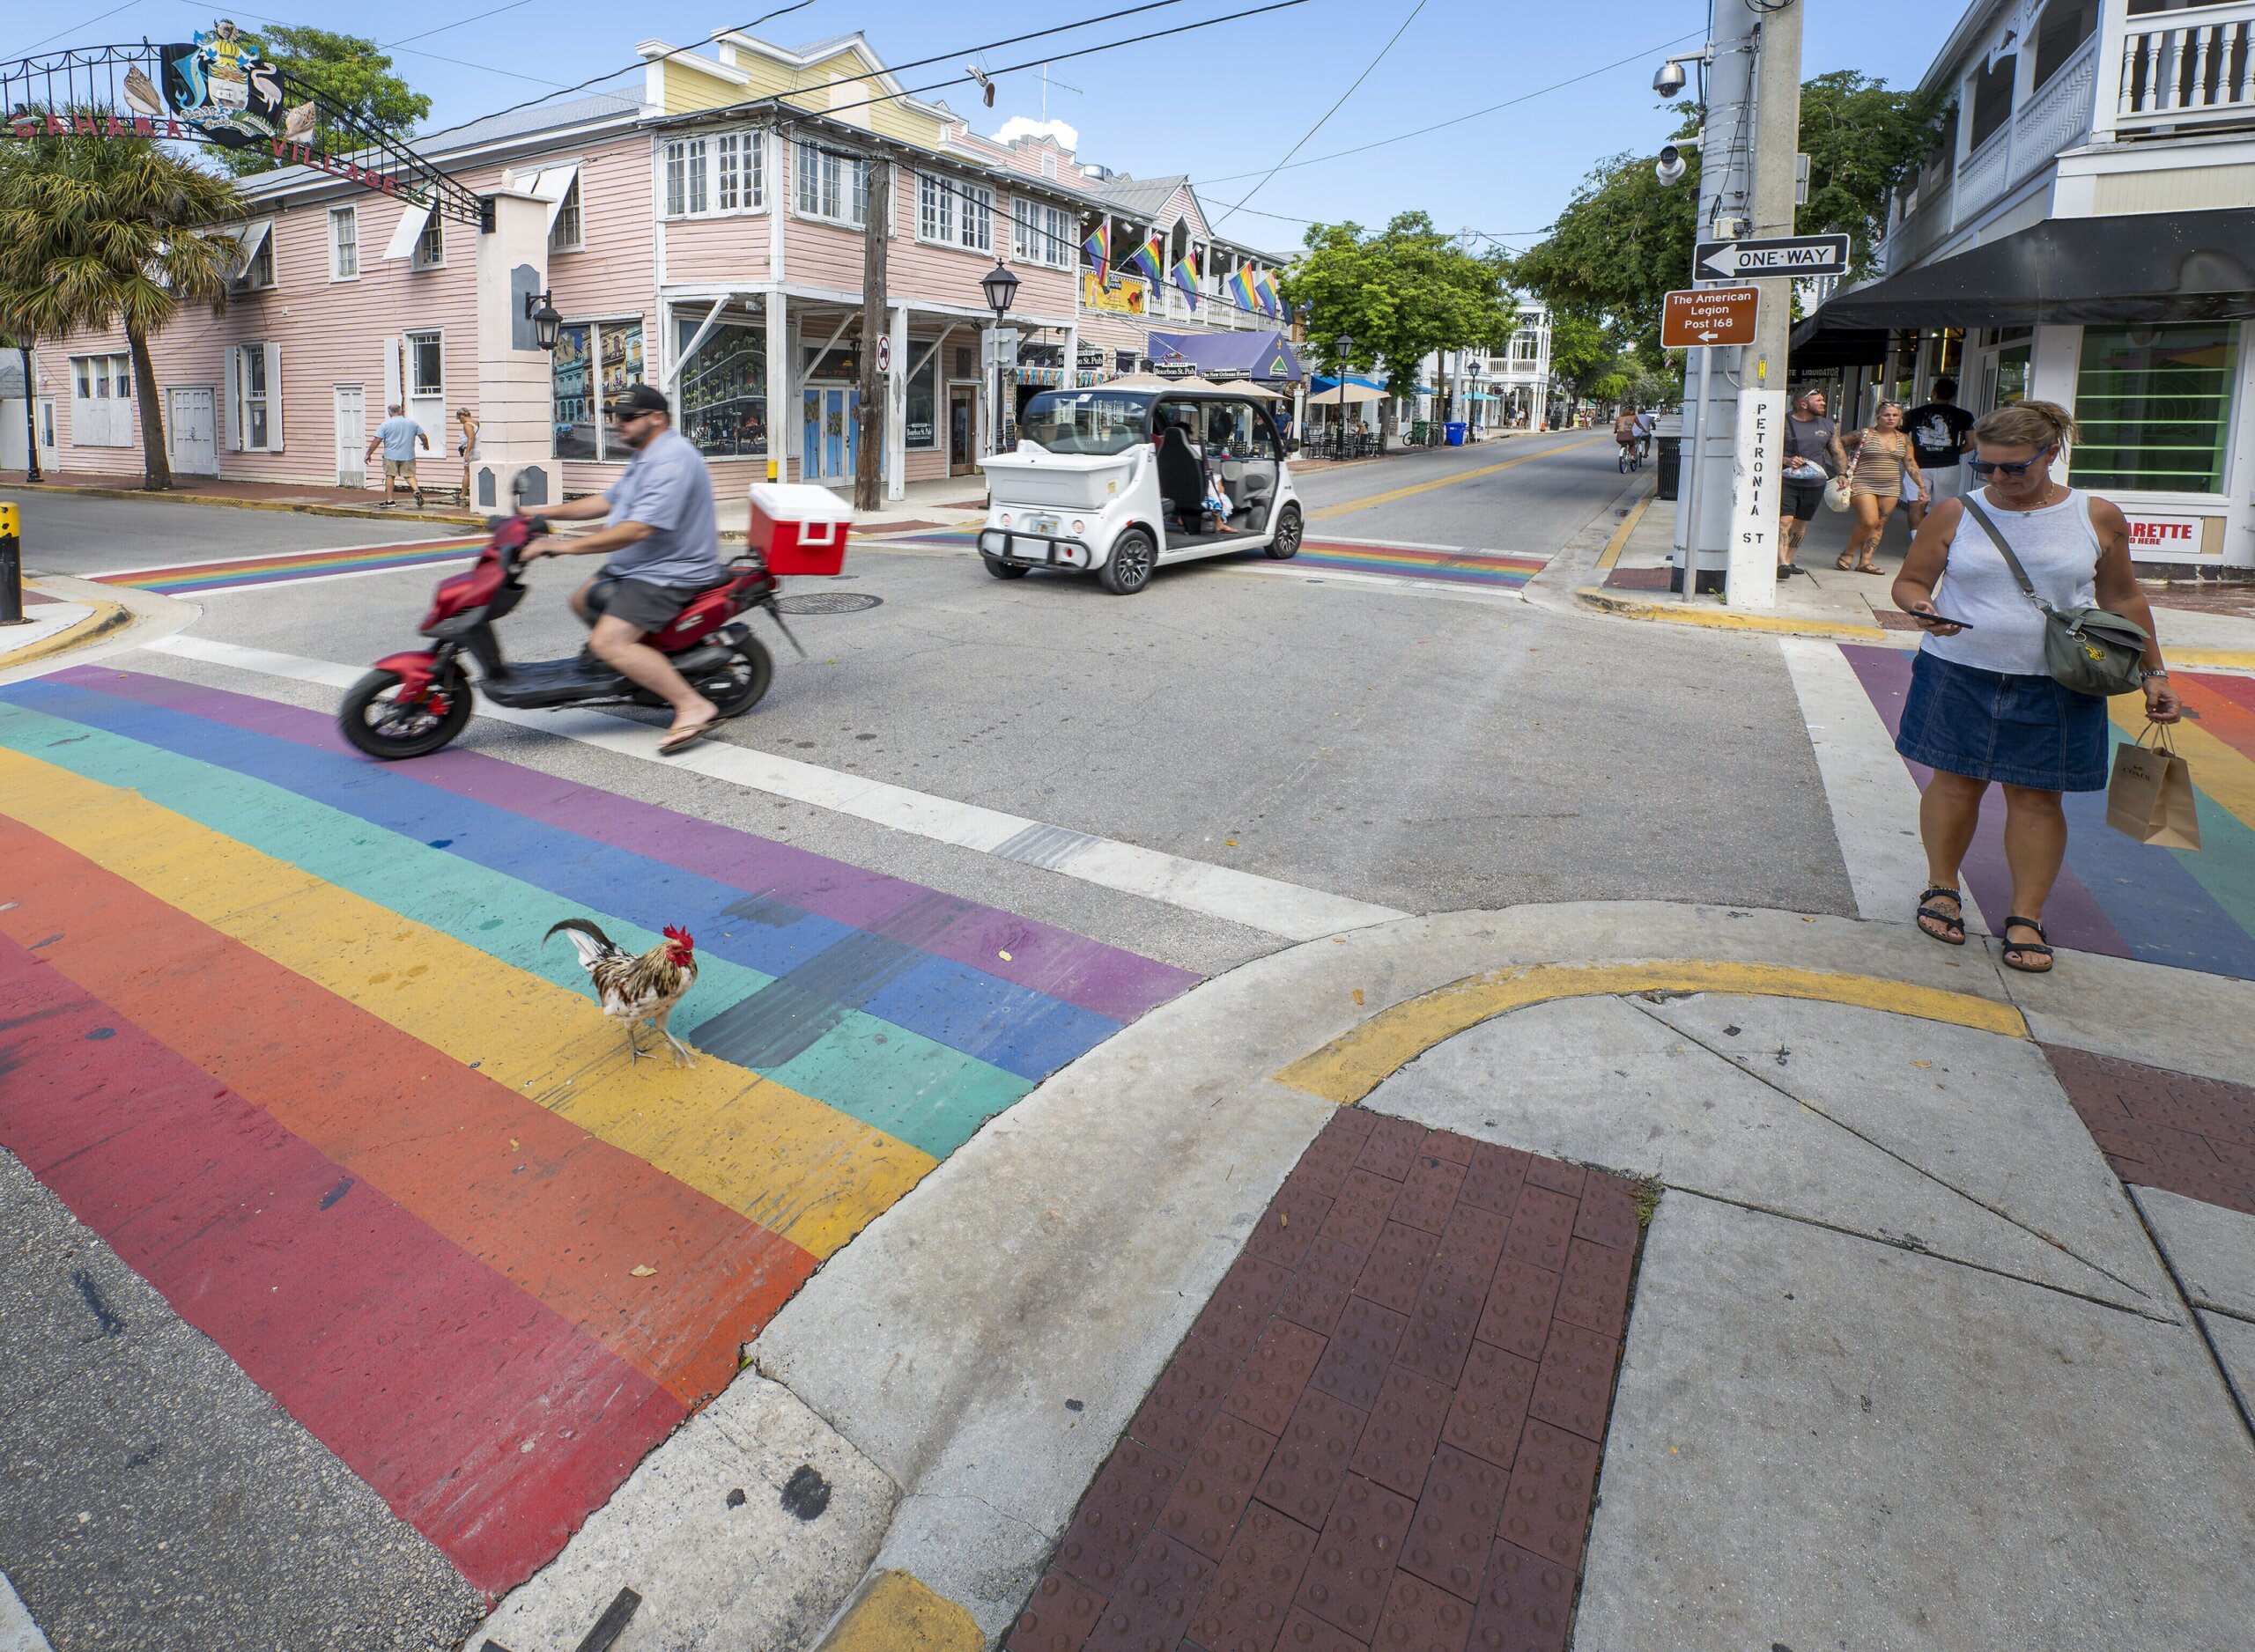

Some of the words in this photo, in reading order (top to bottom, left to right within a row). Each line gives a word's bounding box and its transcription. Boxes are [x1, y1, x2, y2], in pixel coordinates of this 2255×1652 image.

[204, 120, 231, 130] UPWARD
[8, 113, 184, 139] BAHAMA
[271, 137, 399, 196] VILLAGE
[1674, 296, 1692, 305] The
[1696, 292, 1751, 304] American
[1690, 306, 1729, 317] Legion
[1684, 321, 1709, 329] Post
[1713, 318, 1734, 328] 168
[1091, 356, 1103, 365] Pub
[1801, 367, 1839, 377] LIQUIDATOR
[1750, 403, 1767, 516] PETRONIA
[1742, 533, 1764, 544] ST
[2123, 767, 2150, 781] COACH
